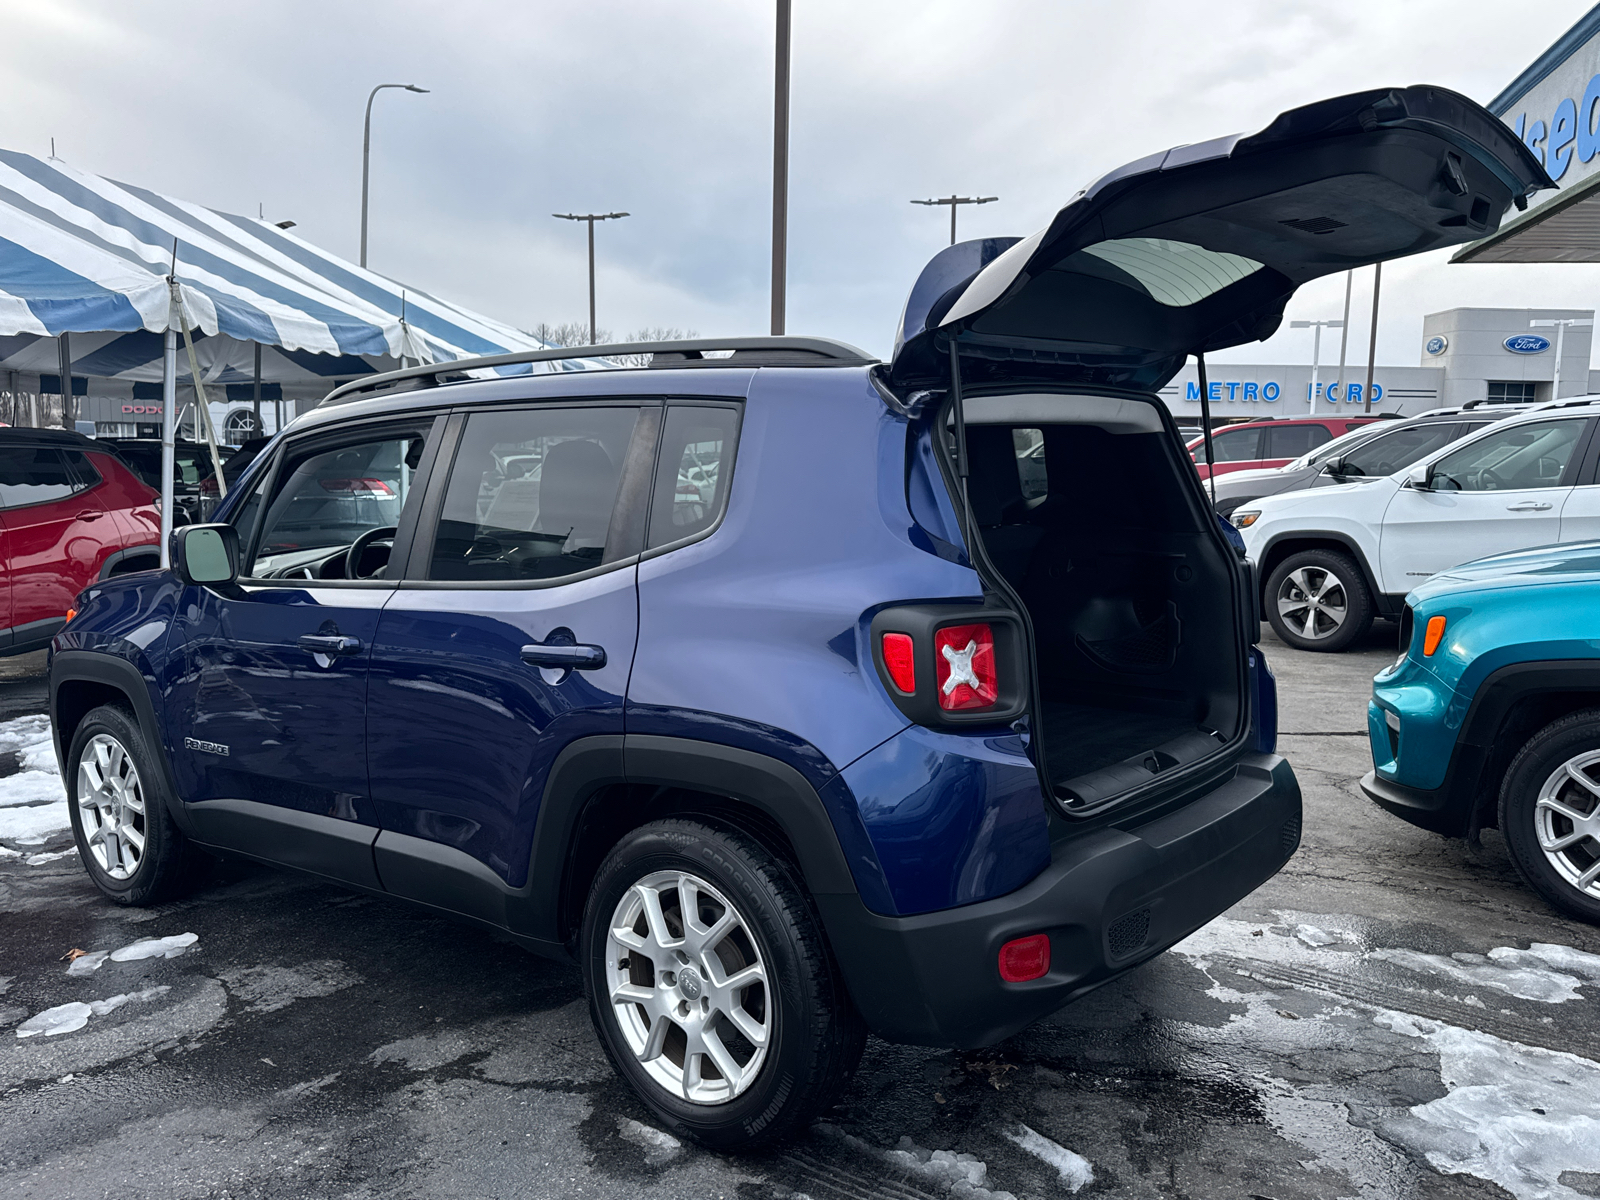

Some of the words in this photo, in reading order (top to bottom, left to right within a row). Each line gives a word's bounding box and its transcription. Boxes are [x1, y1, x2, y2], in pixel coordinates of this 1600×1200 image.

[1185, 381, 1281, 402] METRO
[1307, 382, 1384, 403] FORD
[184, 736, 230, 757] RENEGADE
[702, 847, 782, 947] CROSSOVER
[744, 1090, 789, 1137] MOHAVE
